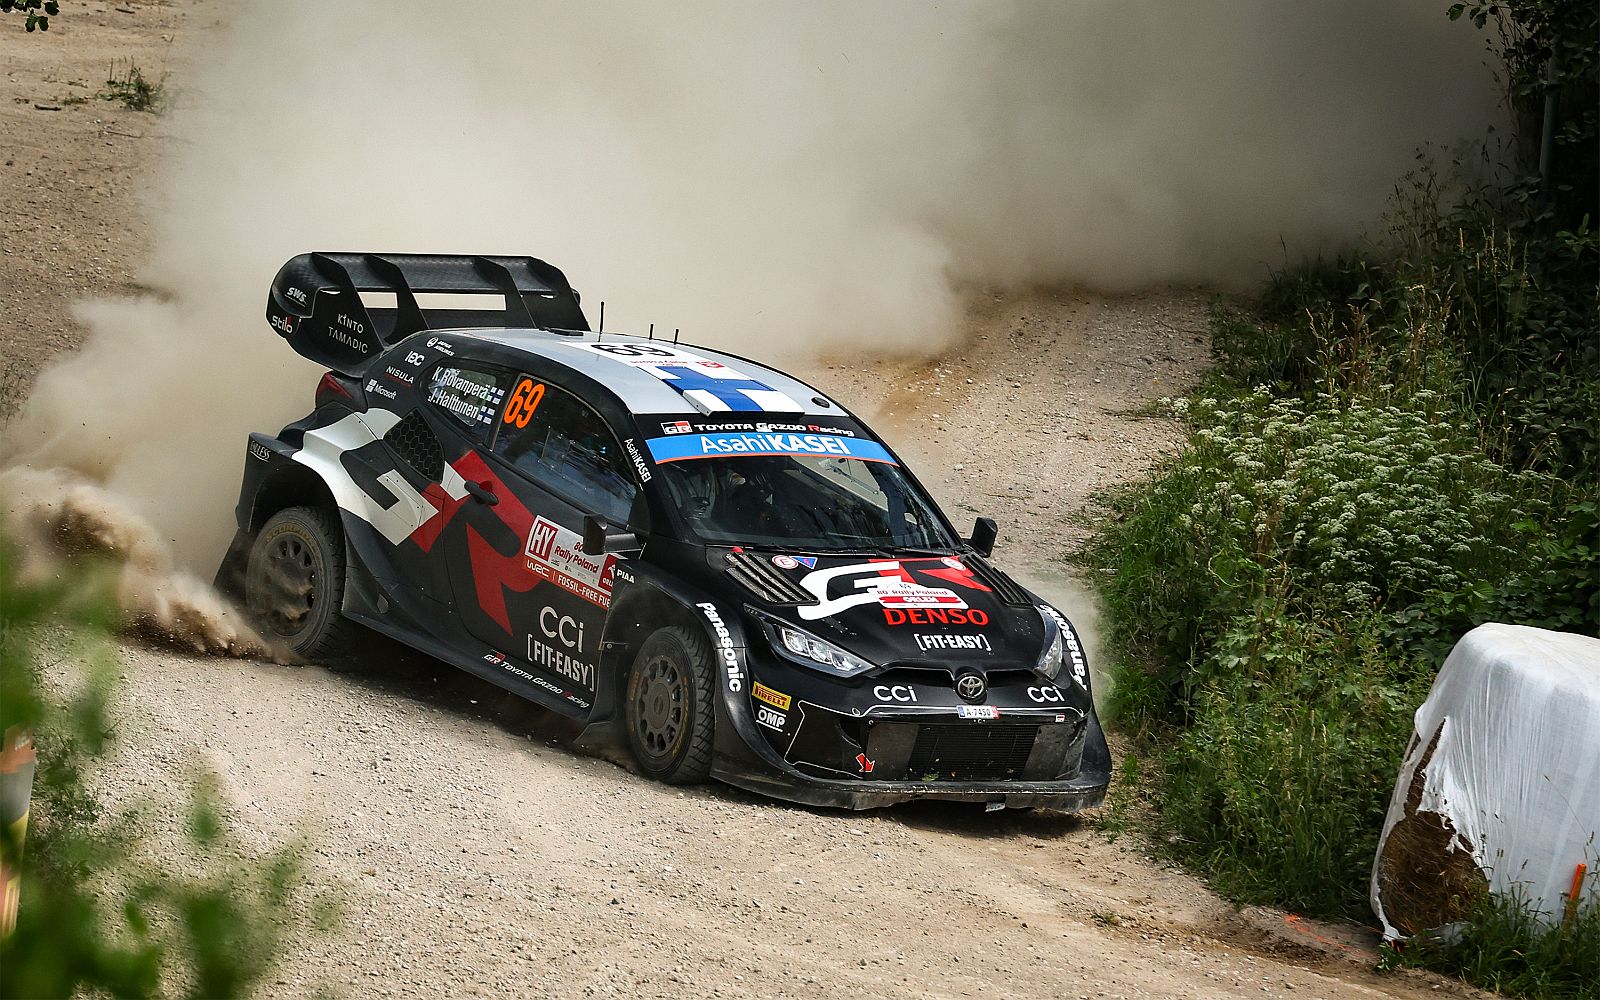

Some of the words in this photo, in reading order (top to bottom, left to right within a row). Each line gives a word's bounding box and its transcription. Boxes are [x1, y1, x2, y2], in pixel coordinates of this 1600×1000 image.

[271, 315, 293, 334] Stilo
[337, 313, 364, 334] KINTO
[328, 326, 368, 354] TAMADIC
[385, 365, 415, 384] NISULA
[374, 383, 397, 400] Microsoft
[503, 378, 546, 429] 69
[664, 425, 693, 434] GR
[694, 423, 754, 432] TOYOTA
[755, 421, 807, 433] GAZOO
[806, 424, 855, 437] Racing
[700, 434, 852, 455] AsahiKASEI
[624, 438, 652, 483] AsahiKASEI
[530, 522, 557, 562] HY
[526, 559, 550, 578] WRC
[554, 545, 574, 563] Rally
[572, 554, 600, 574] Poland
[616, 568, 635, 584] PIAA
[557, 574, 598, 602] FOSSIL-FREE
[882, 608, 990, 626] DENSO
[696, 602, 742, 693] Panasonic
[483, 654, 501, 665] GR
[500, 661, 534, 681] TOYOTA
[531, 677, 564, 694] GAZOO
[562, 690, 590, 708] Racing
[755, 684, 788, 708] PIRELLI
[757, 708, 787, 728] OMP
